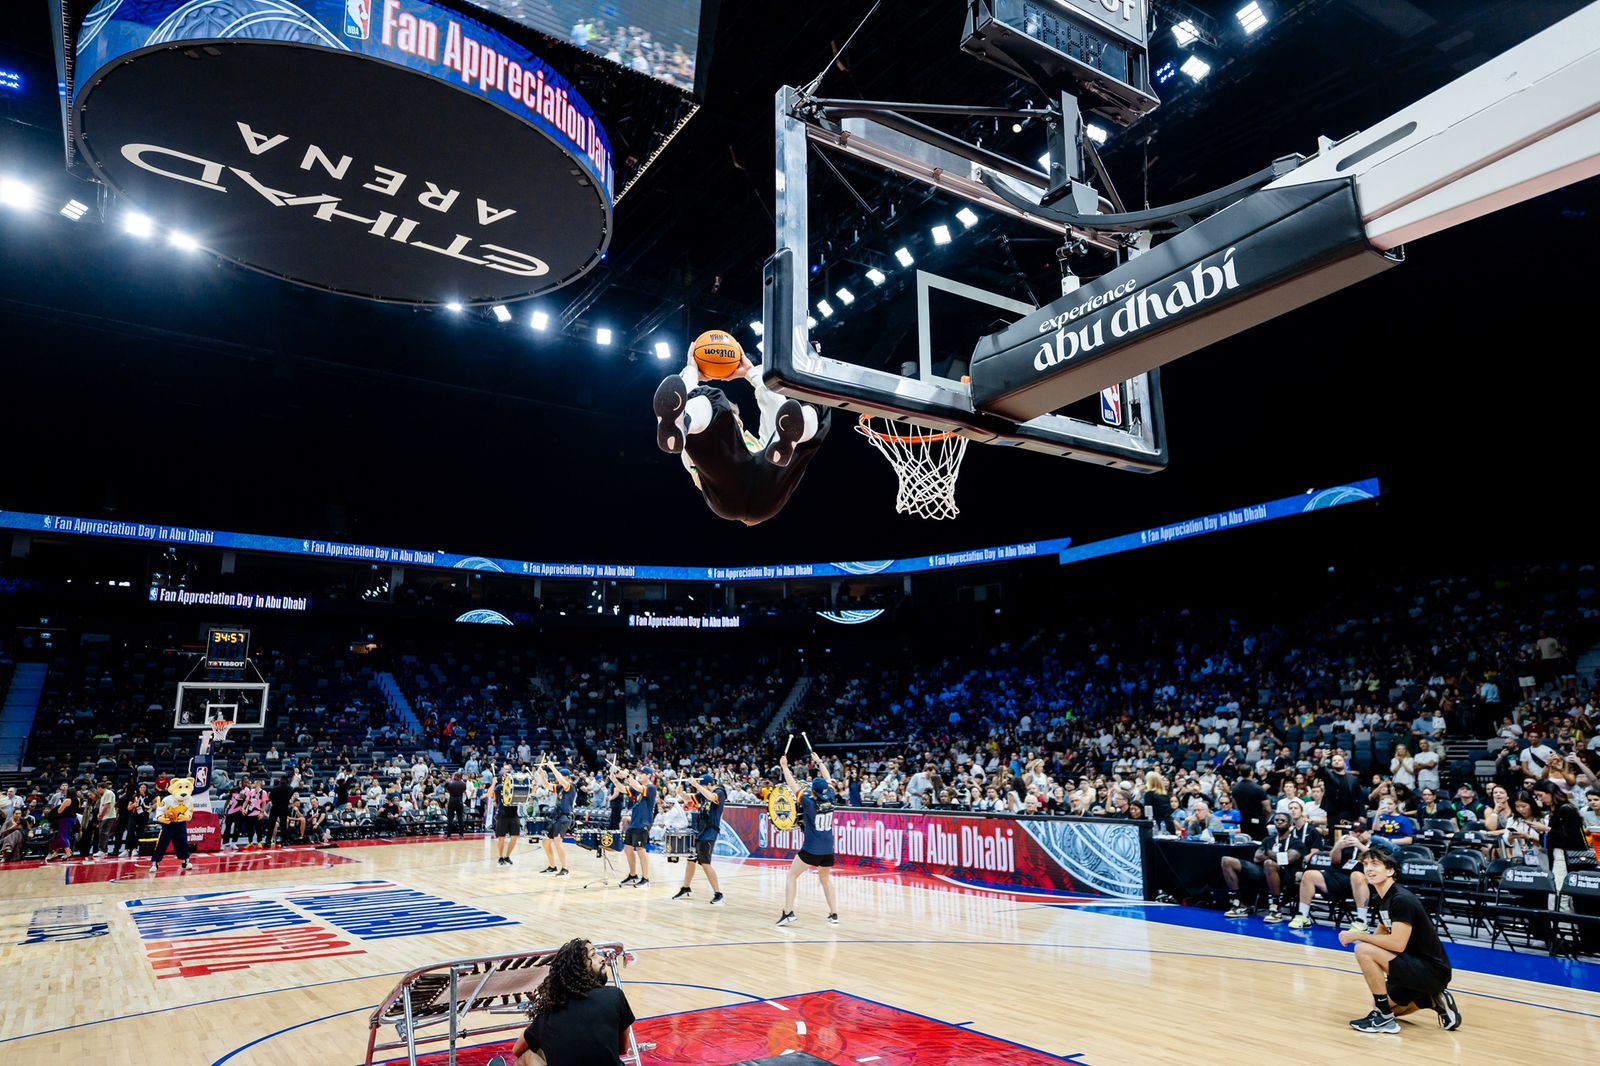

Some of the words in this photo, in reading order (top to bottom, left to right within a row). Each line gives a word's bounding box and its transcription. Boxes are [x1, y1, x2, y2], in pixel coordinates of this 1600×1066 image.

[347, 25, 360, 36] NBA
[381, 0, 439, 61] Fan
[443, 19, 586, 151] Appreciation
[588, 116, 606, 183] Day
[236, 121, 517, 226] ARENA
[119, 143, 550, 276] ETIHAD
[704, 348, 736, 359] Wilson
[1033, 318, 1105, 371] abu
[54, 516, 72, 531] Fan
[74, 519, 136, 537] Appreciation
[138, 524, 156, 540] Day
[159, 527, 168, 539] in
[169, 528, 187, 541] Abu
[188, 529, 214, 544] Dhabi
[1148, 530, 1159, 542] Fan
[1160, 520, 1203, 541] Appreciation
[1204, 517, 1218, 530] Day
[1229, 511, 1243, 525] Abu
[1244, 505, 1266, 521] Dhabi
[311, 540, 325, 553] Fan
[326, 542, 374, 557] Appreciation
[375, 547, 389, 560] Day
[392, 548, 398, 560] in
[399, 550, 413, 562] Abu
[414, 551, 434, 564] Dhabi
[935, 556, 946, 566] Fan
[946, 550, 984, 566] Appreciation
[984, 549, 996, 560] Day
[1005, 546, 1017, 557] Abu
[1018, 543, 1036, 555] Dhabi
[529, 562, 540, 573] Fan
[541, 564, 582, 576] Appreciation
[582, 565, 595, 577] Day
[596, 565, 603, 576] in
[604, 566, 616, 576] Abu
[616, 566, 635, 577] Dhabi
[714, 568, 725, 578] Fan
[726, 568, 763, 580] Appreciation
[764, 567, 775, 578] Day
[776, 566, 783, 576] in
[784, 566, 795, 576] Abu
[796, 565, 812, 576] Dhabi
[160, 588, 176, 602] Fan
[178, 589, 235, 605] Appreciation
[236, 593, 254, 608] Day
[256, 594, 264, 607] in
[265, 595, 281, 609] Abu
[282, 596, 306, 610] Dhabi
[636, 615, 647, 626] Fan
[648, 615, 688, 628] Appreciation
[688, 616, 700, 628] Day
[702, 616, 709, 627] in
[709, 616, 721, 627] Abu
[722, 616, 740, 627] Dhabi
[214, 632, 245, 643] 34:57
[876, 820, 903, 867] Day
[908, 823, 924, 863] in
[927, 823, 958, 867] Abu
[961, 825, 1015, 873] Dhabi
